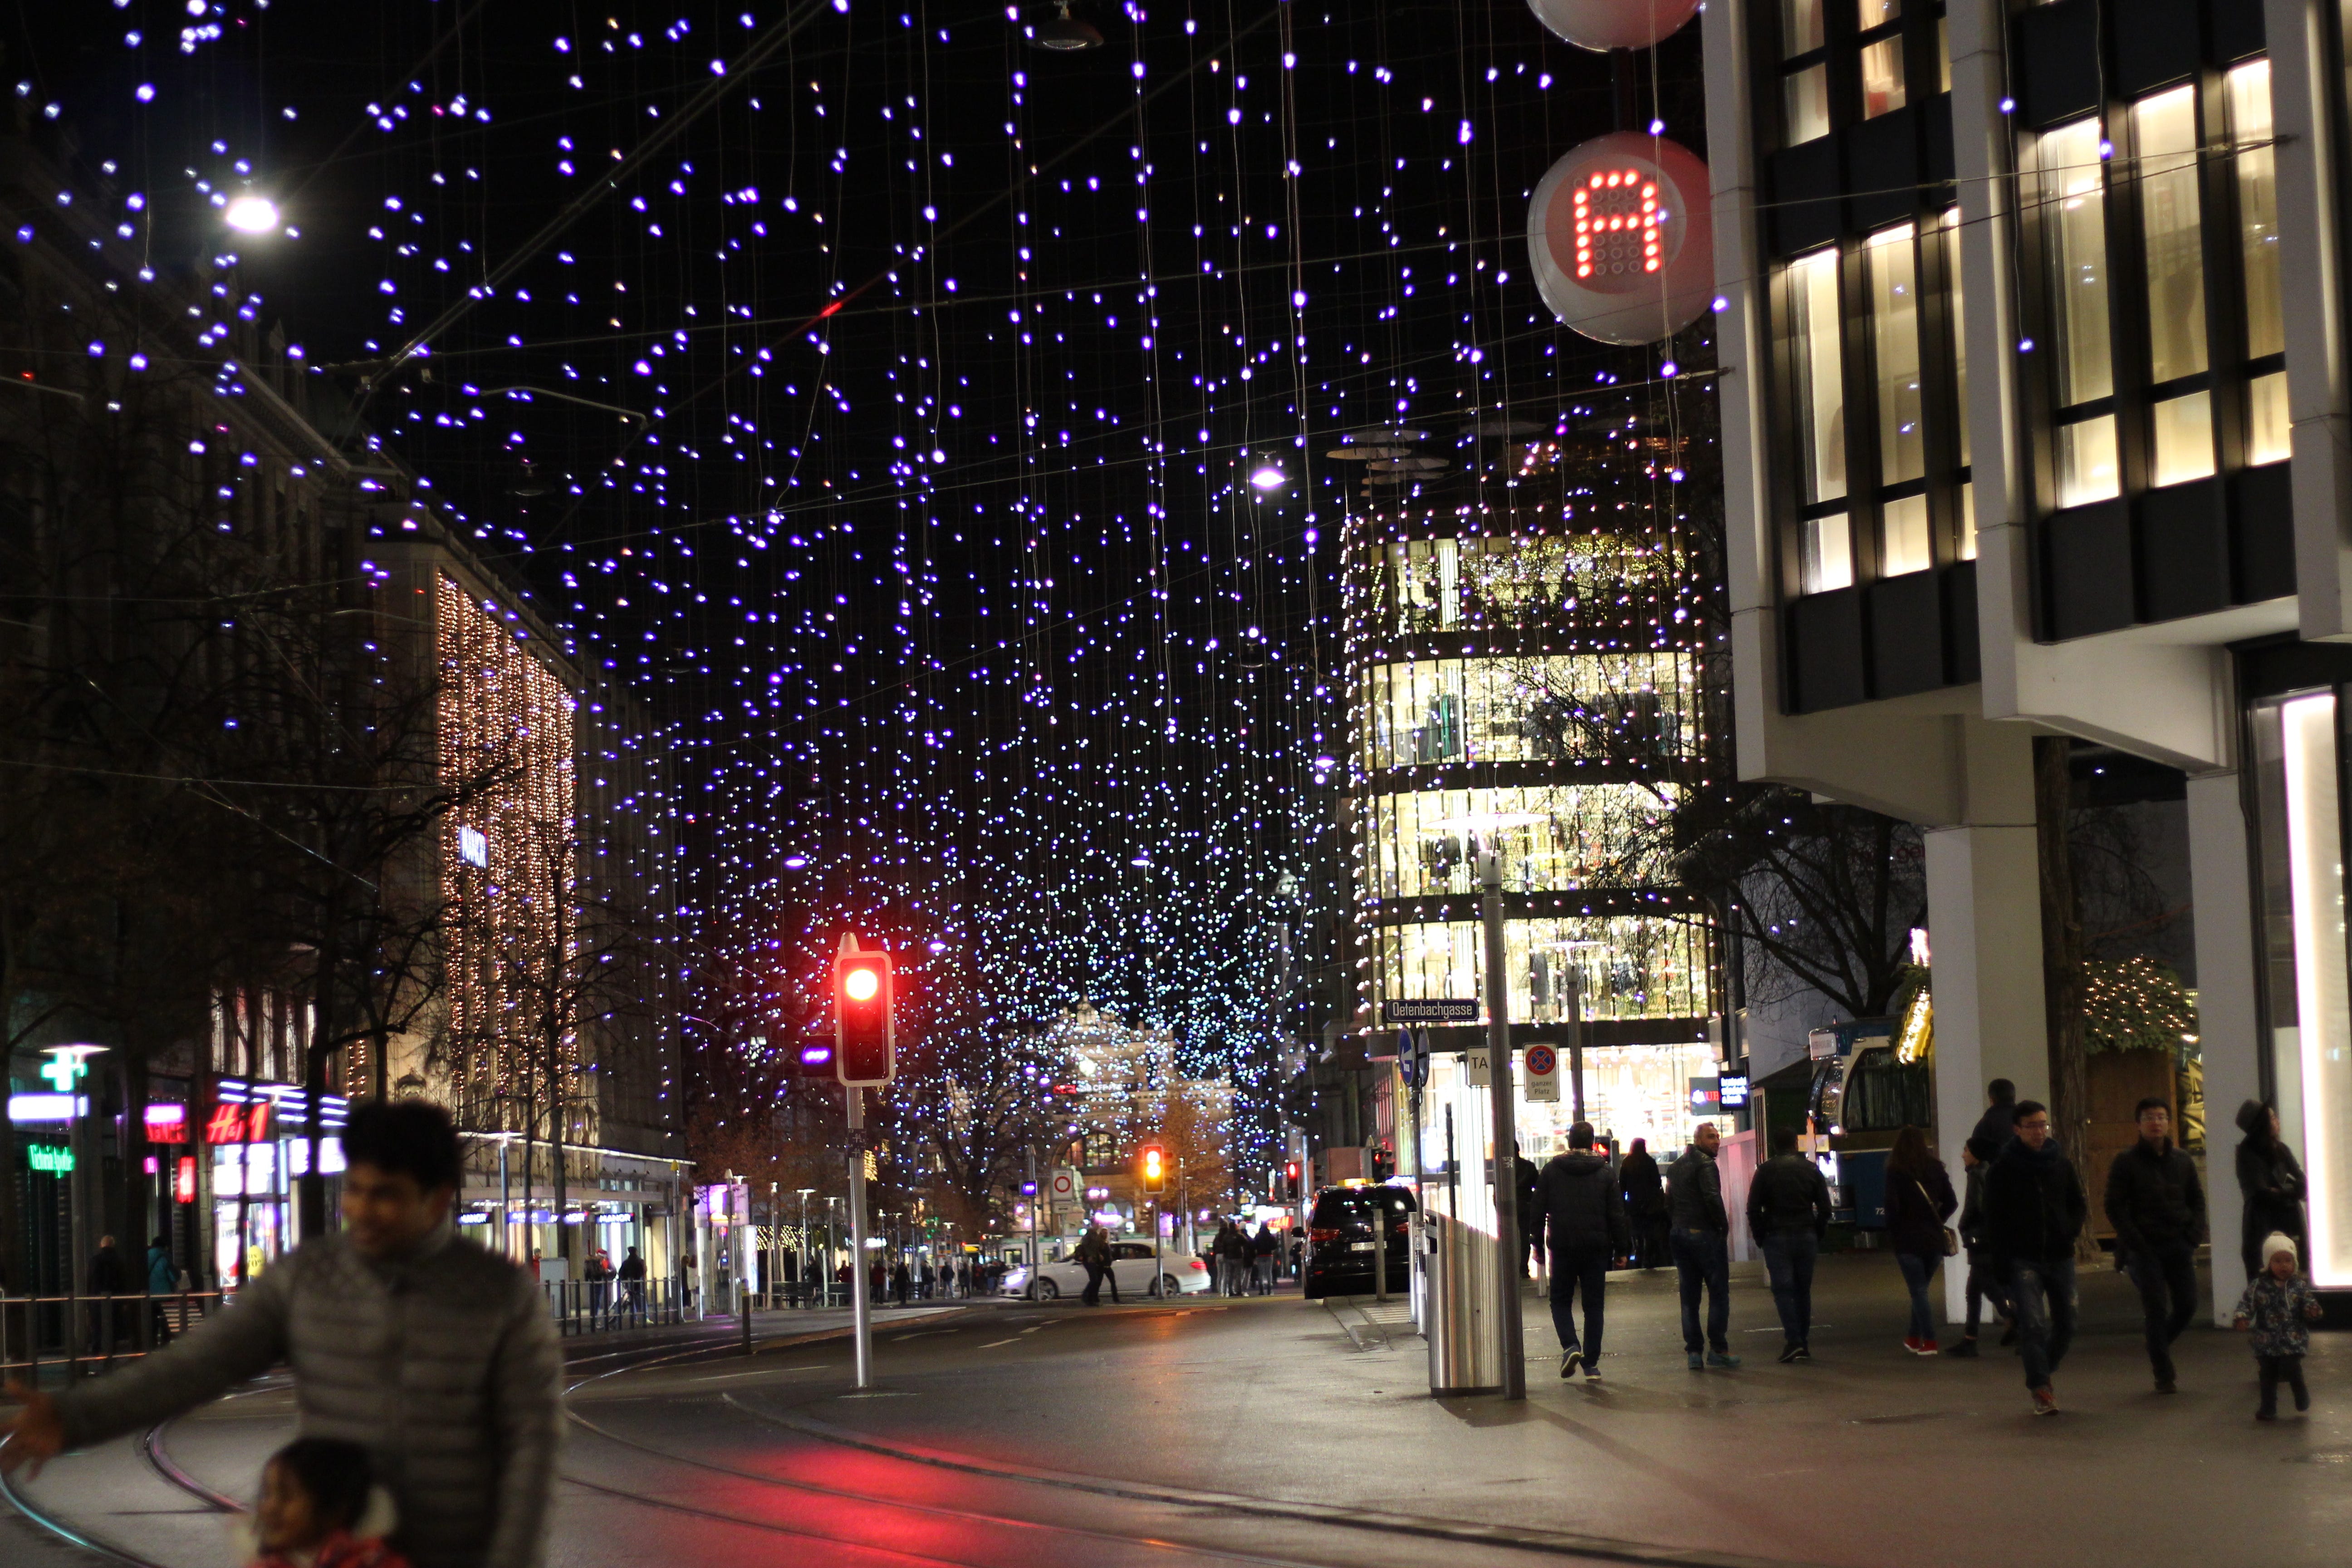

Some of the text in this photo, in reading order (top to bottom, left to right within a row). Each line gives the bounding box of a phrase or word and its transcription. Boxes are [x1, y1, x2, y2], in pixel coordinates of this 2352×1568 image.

[462, 825, 486, 869] MANOR
[1392, 1001, 1472, 1019] Oetenbachgasse
[1472, 1057, 1488, 1069] TA
[1705, 1091, 1720, 1101] UB
[598, 1213, 631, 1223] MANOR
